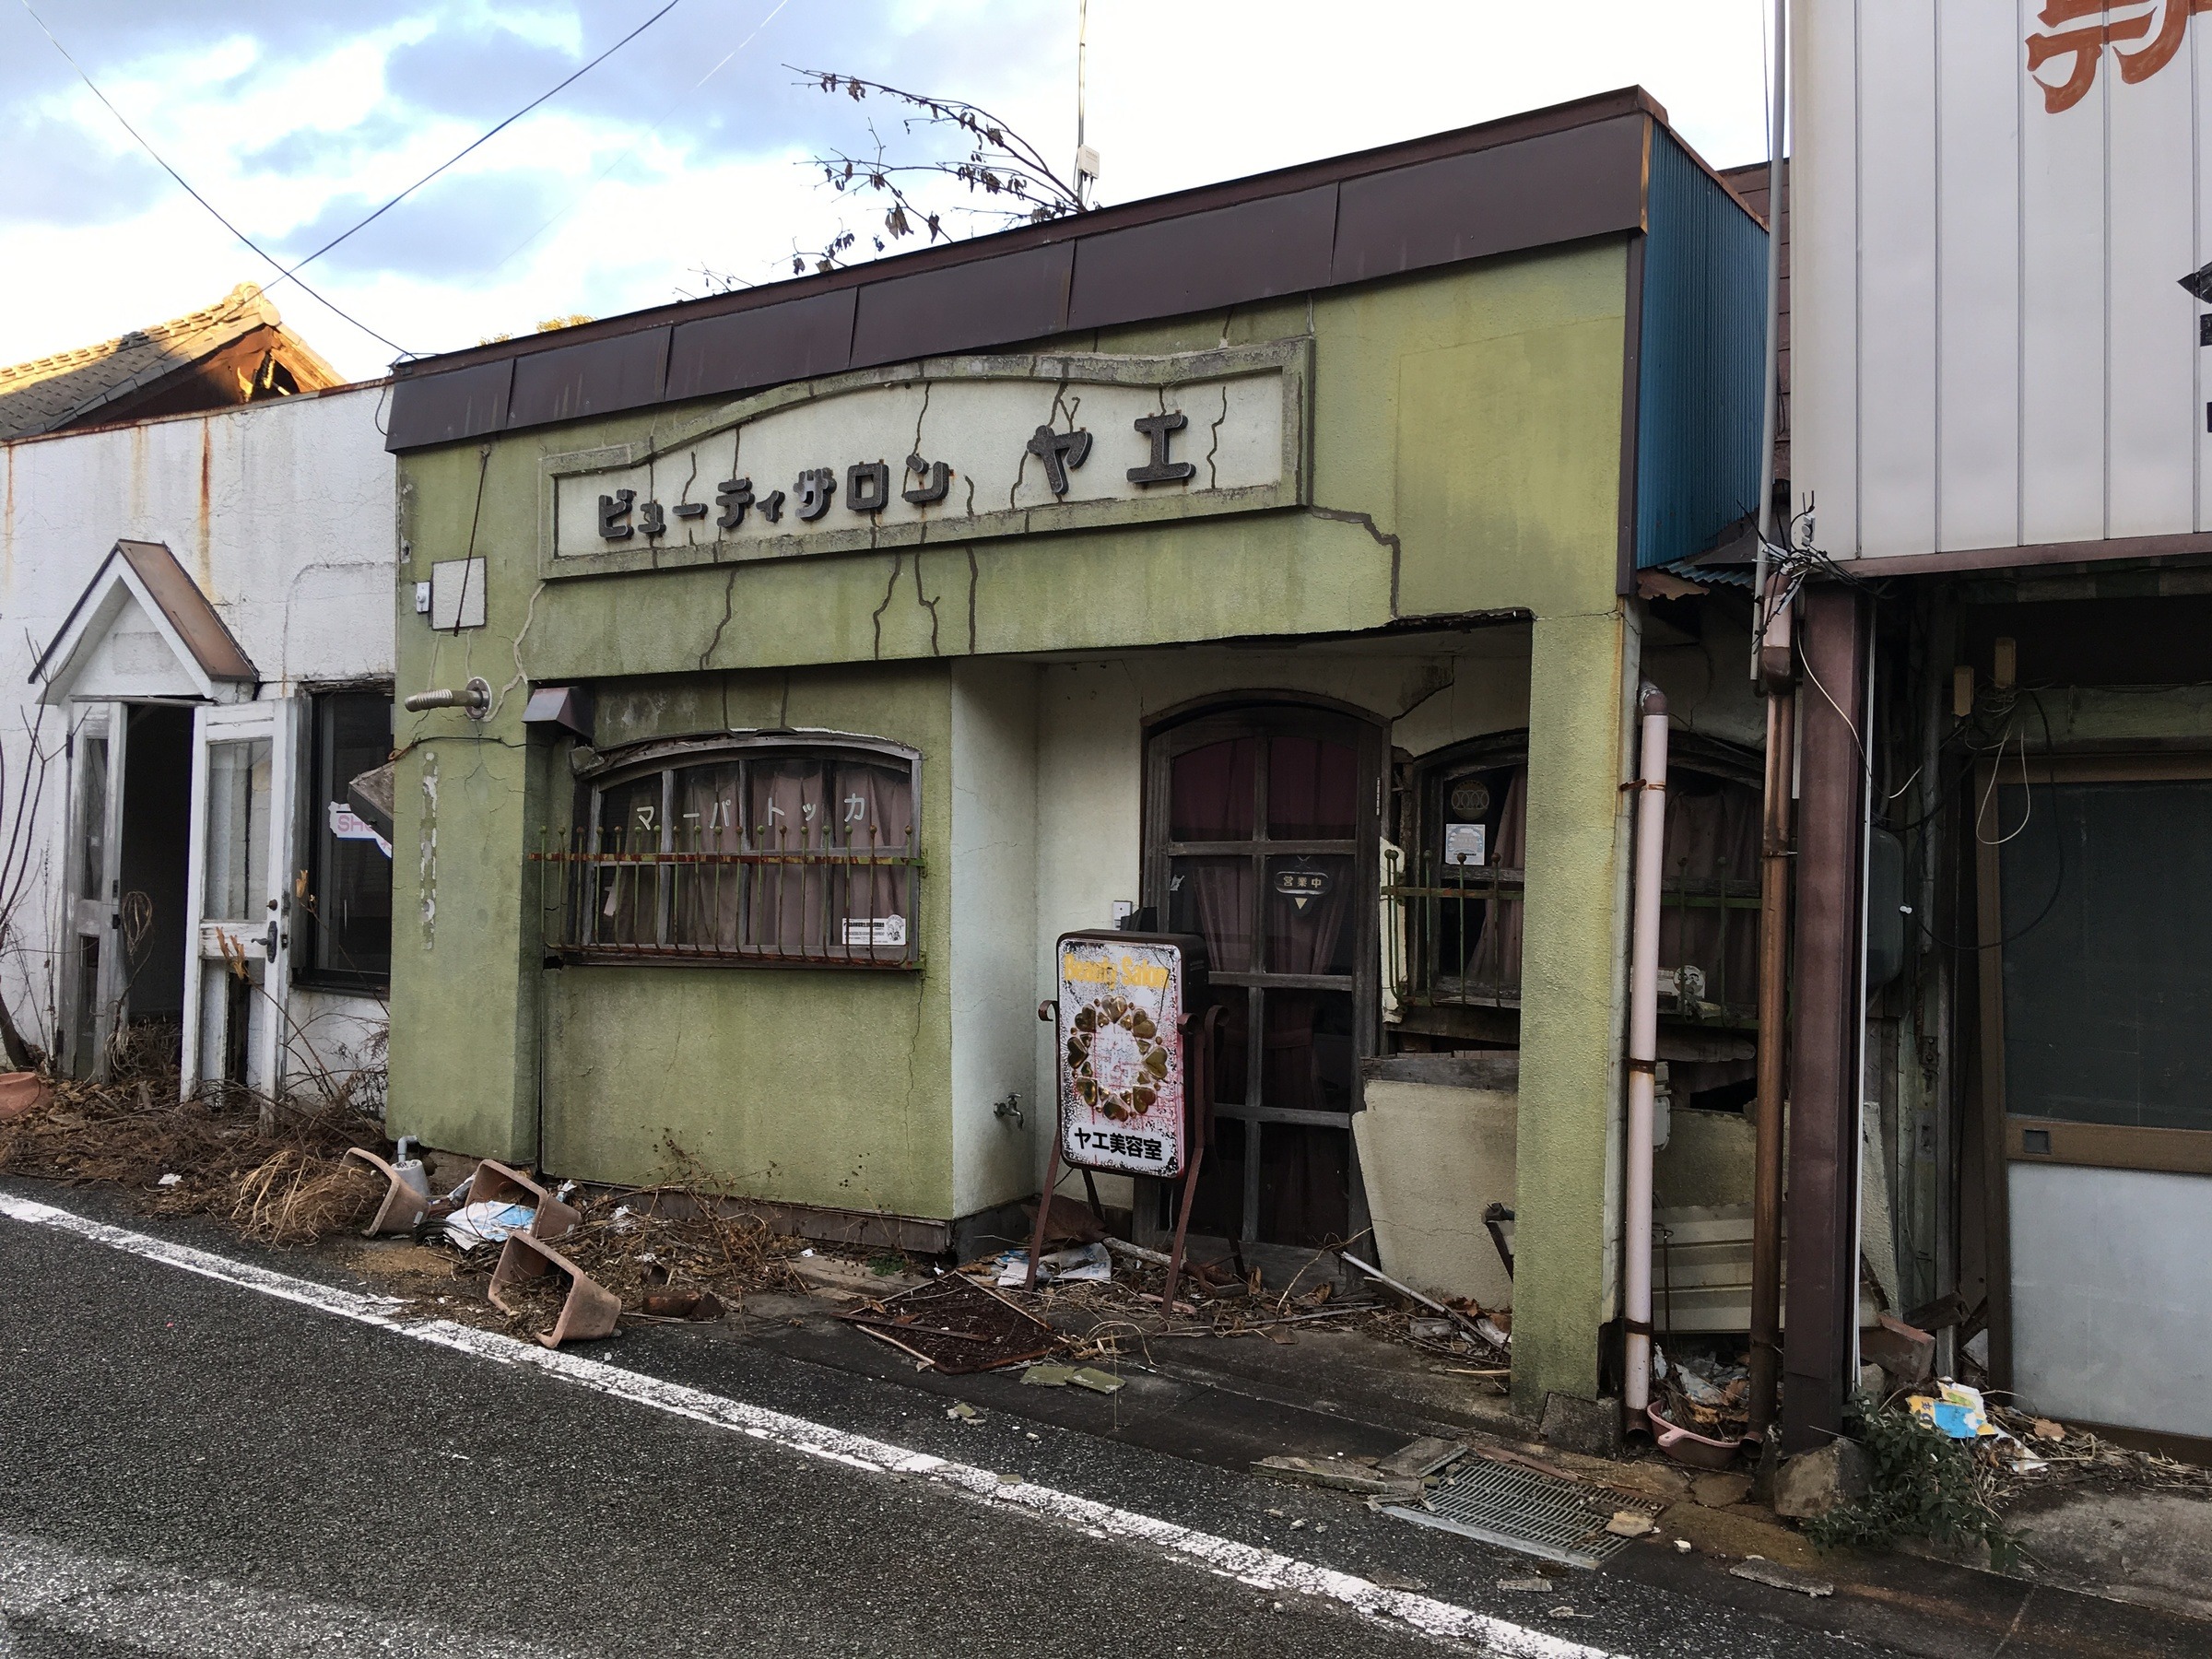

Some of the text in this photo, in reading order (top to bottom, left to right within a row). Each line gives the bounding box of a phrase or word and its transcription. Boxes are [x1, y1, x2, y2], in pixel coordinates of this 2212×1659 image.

[1027, 413, 1196, 496] ヤエ
[1283, 875, 1322, 888] 営業中
[1064, 952, 1171, 991] Beauty Salon
[1074, 1126, 1163, 1161] ヤエ美容室
